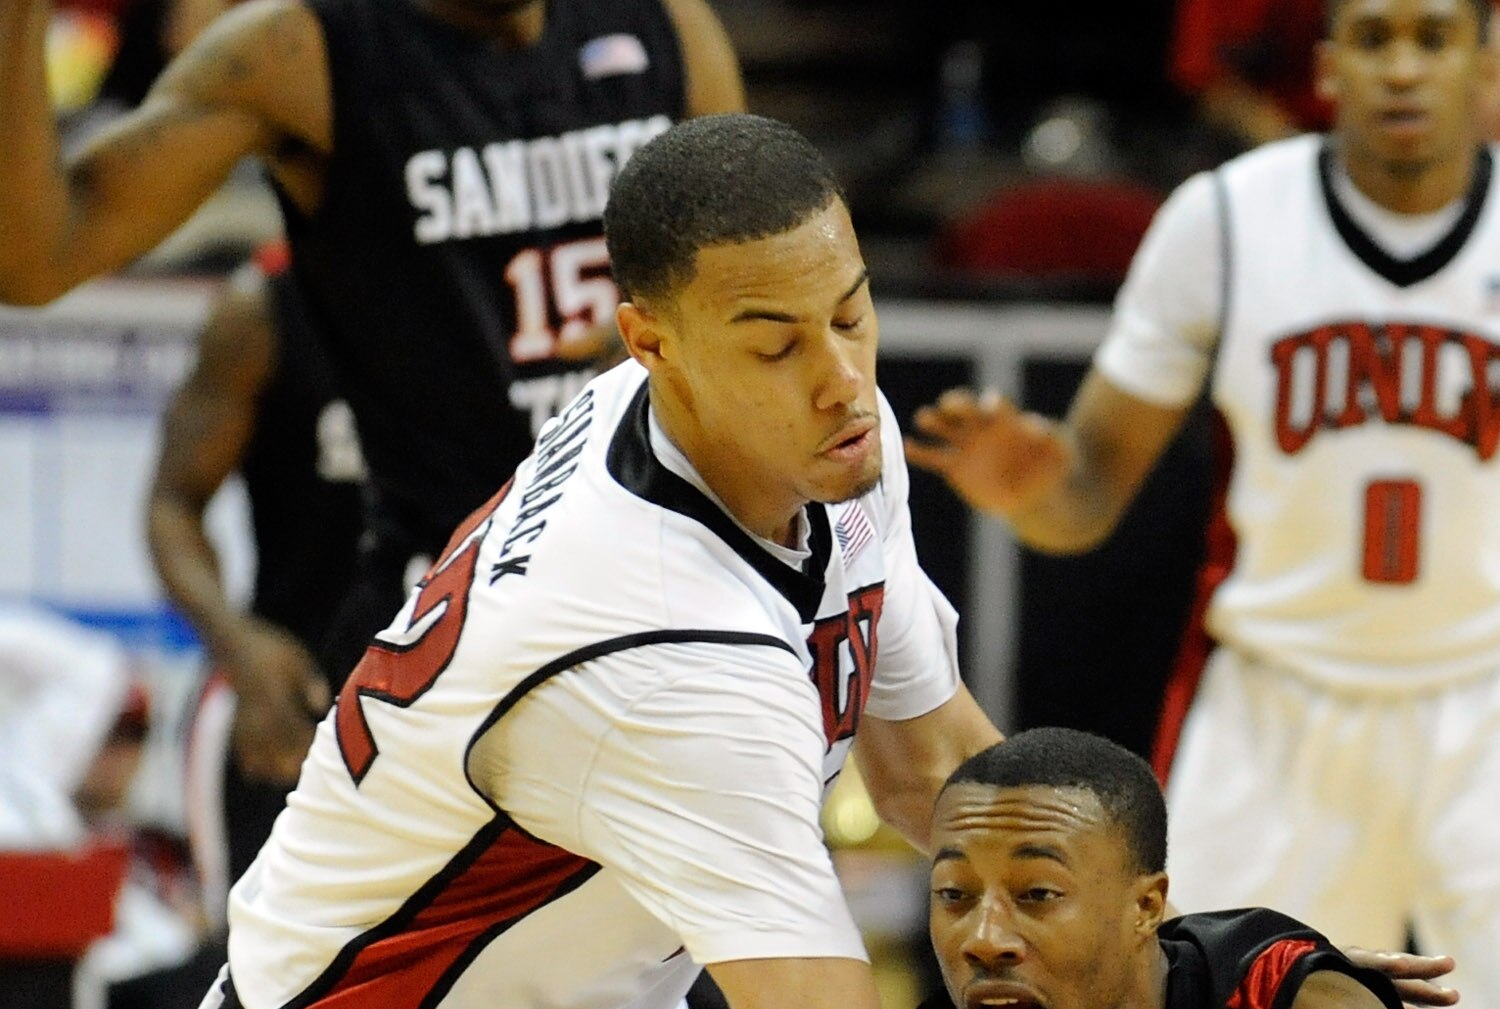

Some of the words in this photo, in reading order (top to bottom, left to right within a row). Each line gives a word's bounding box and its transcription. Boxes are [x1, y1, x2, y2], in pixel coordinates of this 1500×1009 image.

[503, 234, 622, 366] 15
[489, 388, 595, 587] STANBACK
[1361, 476, 1424, 587] 0
